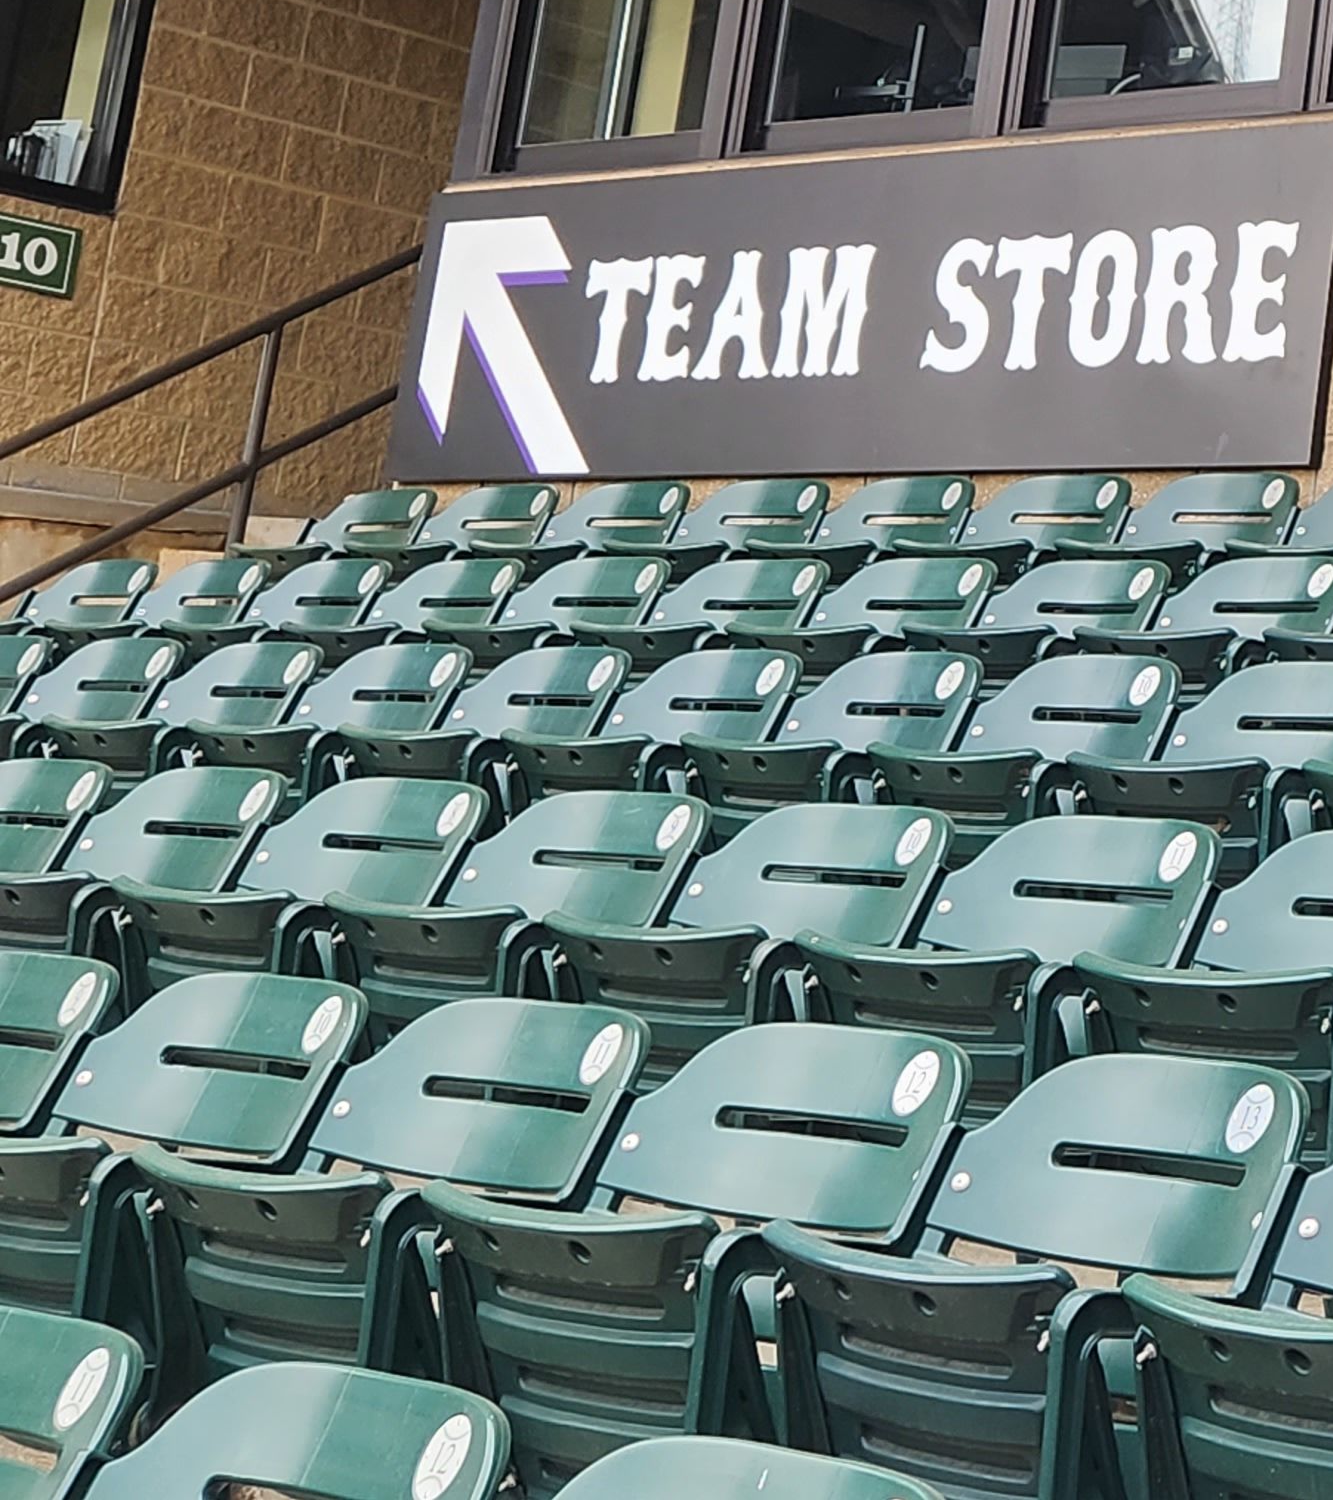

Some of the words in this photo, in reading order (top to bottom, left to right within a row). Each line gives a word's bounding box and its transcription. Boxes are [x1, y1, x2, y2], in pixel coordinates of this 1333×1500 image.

[0, 232, 59, 277] 10
[585, 243, 877, 385] TEAM
[919, 219, 1300, 373] STORE
[1169, 847, 1185, 866] 11
[314, 1012, 330, 1034] 10
[592, 1041, 611, 1065] 11
[905, 1070, 925, 1094] 12
[1239, 1104, 1262, 1131] 13
[71, 1372, 96, 1403] 11
[428, 1441, 457, 1475] 12
